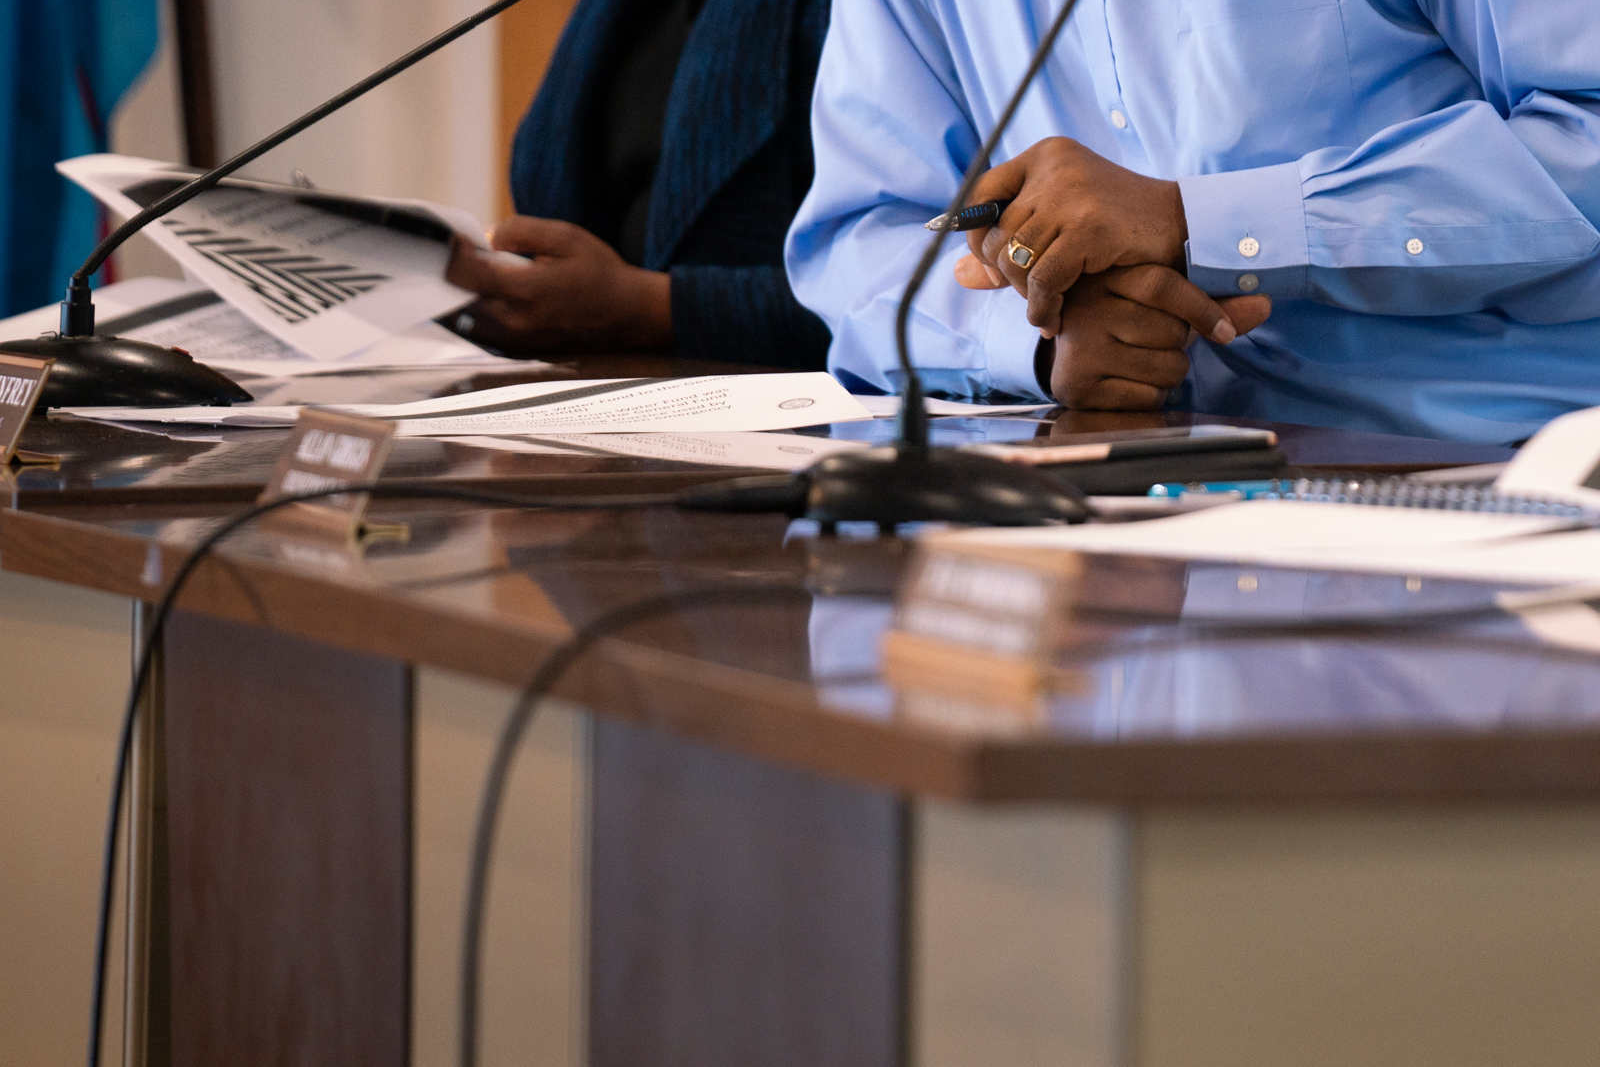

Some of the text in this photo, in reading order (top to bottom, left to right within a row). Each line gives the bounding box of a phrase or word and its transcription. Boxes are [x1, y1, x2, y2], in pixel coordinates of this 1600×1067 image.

[552, 402, 594, 411] Water
[599, 393, 635, 404] Fund
[656, 384, 680, 392] the
[684, 374, 738, 386] General
[615, 402, 659, 413] Water
[662, 393, 698, 405] Fund
[701, 388, 729, 396] was
[633, 401, 689, 415] General
[692, 392, 732, 404] Fund.
[612, 411, 668, 423] practice
[672, 404, 706, 414] used
[654, 404, 732, 420] emergency
